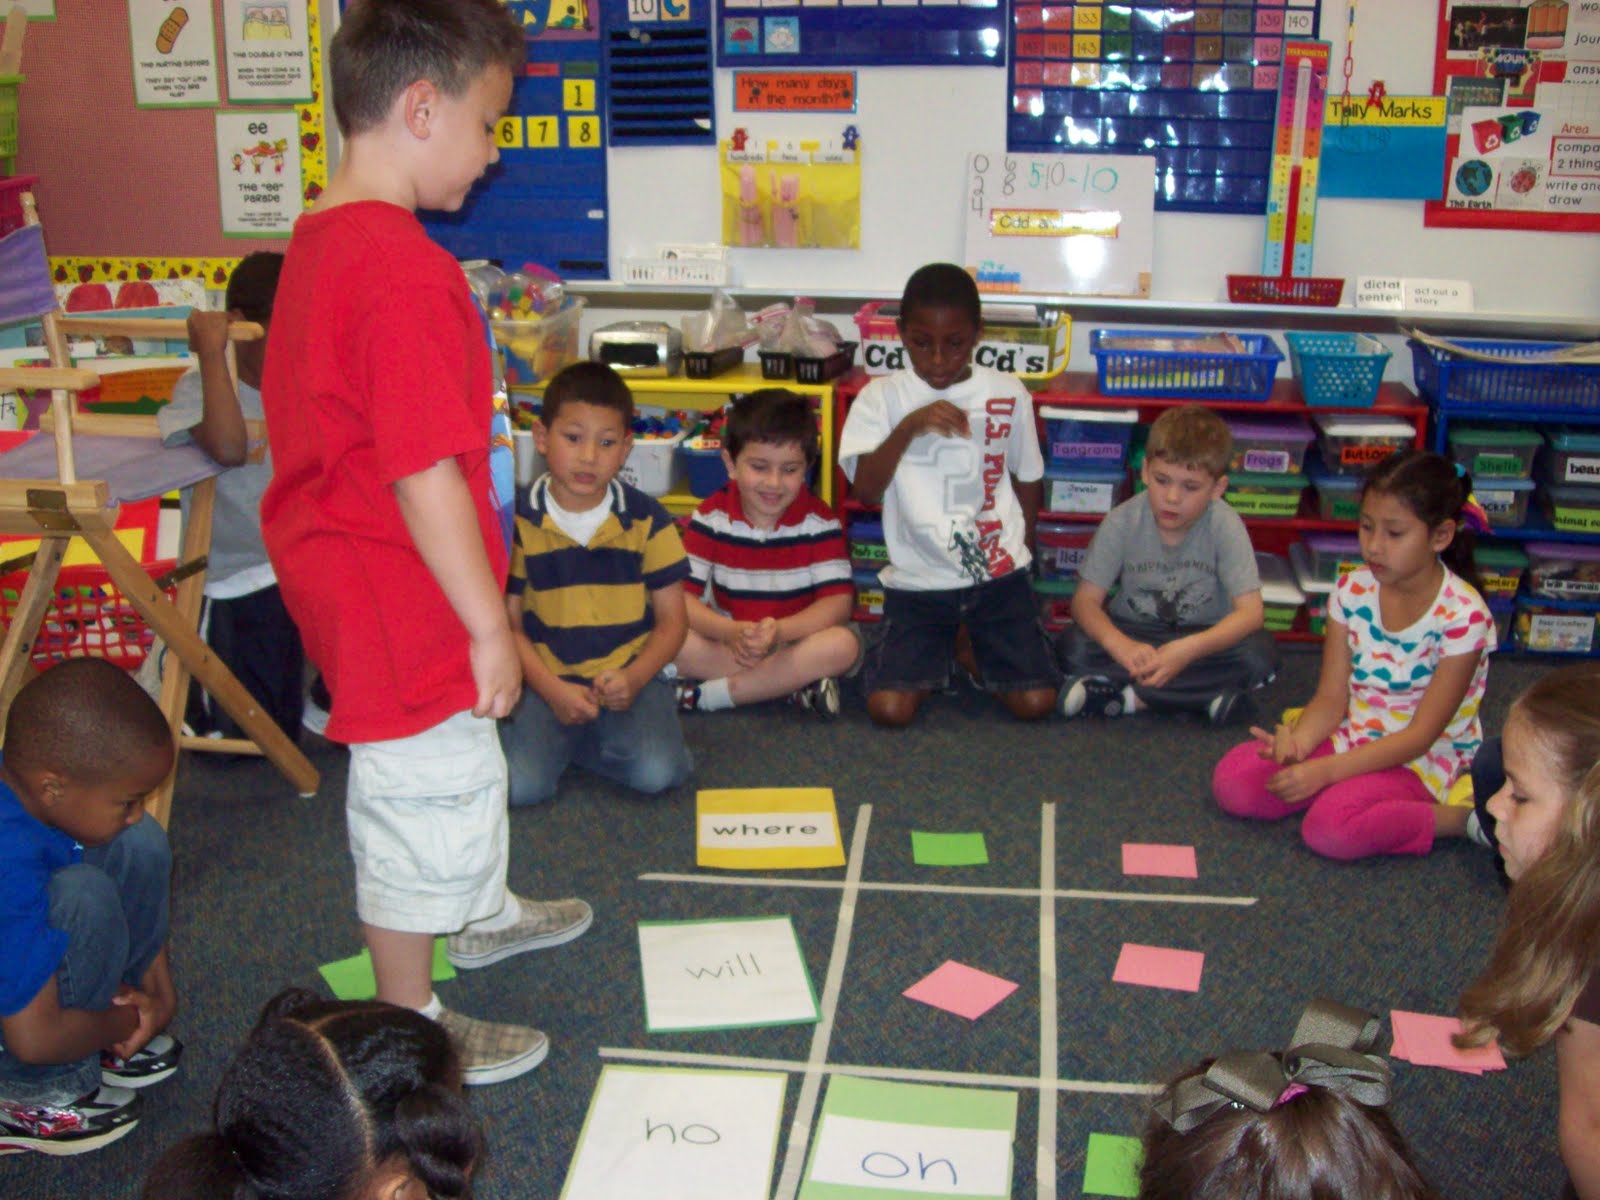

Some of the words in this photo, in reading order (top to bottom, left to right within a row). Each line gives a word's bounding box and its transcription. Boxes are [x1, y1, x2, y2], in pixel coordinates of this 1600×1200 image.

[1077, 13, 1098, 24] 133
[1260, 15, 1281, 27] 139
[1288, 16, 1309, 28] 140
[1077, 41, 1096, 54] 143
[1495, 53, 1527, 64] NOUN
[741, 78, 769, 88] How
[776, 79, 810, 89] many
[817, 77, 847, 89] days
[574, 85, 583, 106] 1
[1330, 101, 1369, 119] Tally
[1379, 101, 1432, 119] Marks
[247, 122, 268, 134] ee
[502, 122, 514, 143] 6
[537, 121, 548, 142] 7
[579, 121, 591, 143] 8
[1561, 123, 1589, 134] Area
[973, 154, 989, 174] 0
[1557, 158, 1565, 169] 2
[1546, 181, 1577, 192] write
[1450, 199, 1466, 209] The
[1467, 199, 1492, 209] Earth
[1548, 193, 1583, 206] draw
[999, 214, 1030, 229] Odd
[1414, 287, 1430, 295] act
[1433, 288, 1448, 296] out
[1414, 296, 1438, 306] story
[975, 344, 1044, 373] Cd's
[1055, 443, 1121, 457] Tangrams
[1247, 453, 1282, 468] Frogs
[711, 821, 819, 837] where
[685, 952, 762, 980] will
[645, 1117, 722, 1145] no
[861, 1150, 958, 1185] on
